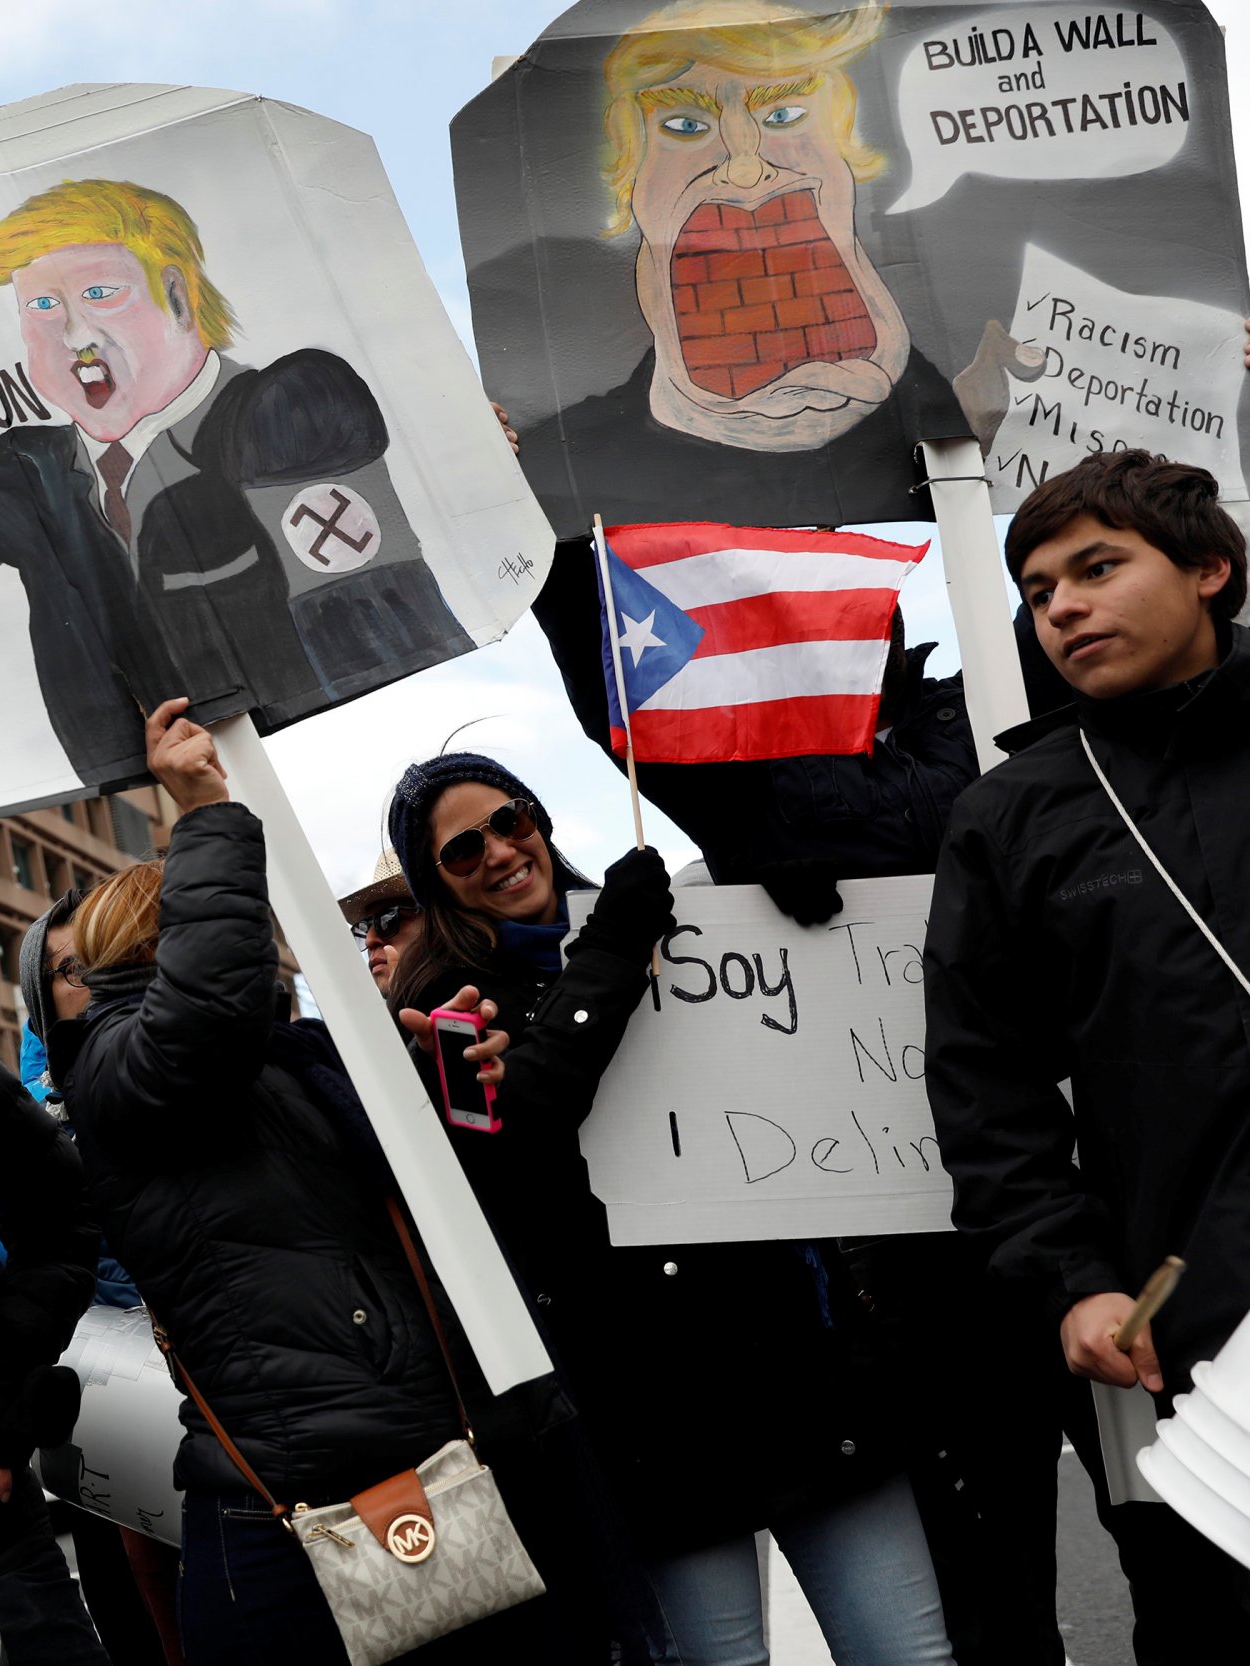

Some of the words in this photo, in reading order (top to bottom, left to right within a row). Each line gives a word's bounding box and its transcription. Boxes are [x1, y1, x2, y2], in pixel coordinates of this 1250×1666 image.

[1022, 22, 1044, 59] A
[1054, 13, 1158, 53] WALL
[997, 61, 1047, 94] and
[1049, 297, 1181, 371] Racism
[1043, 346, 1225, 440] Deportation
[661, 924, 797, 1034] Soy
[828, 920, 928, 986] Tra
[724, 1110, 941, 1184] Delin
[392, 1521, 430, 1556] MK
